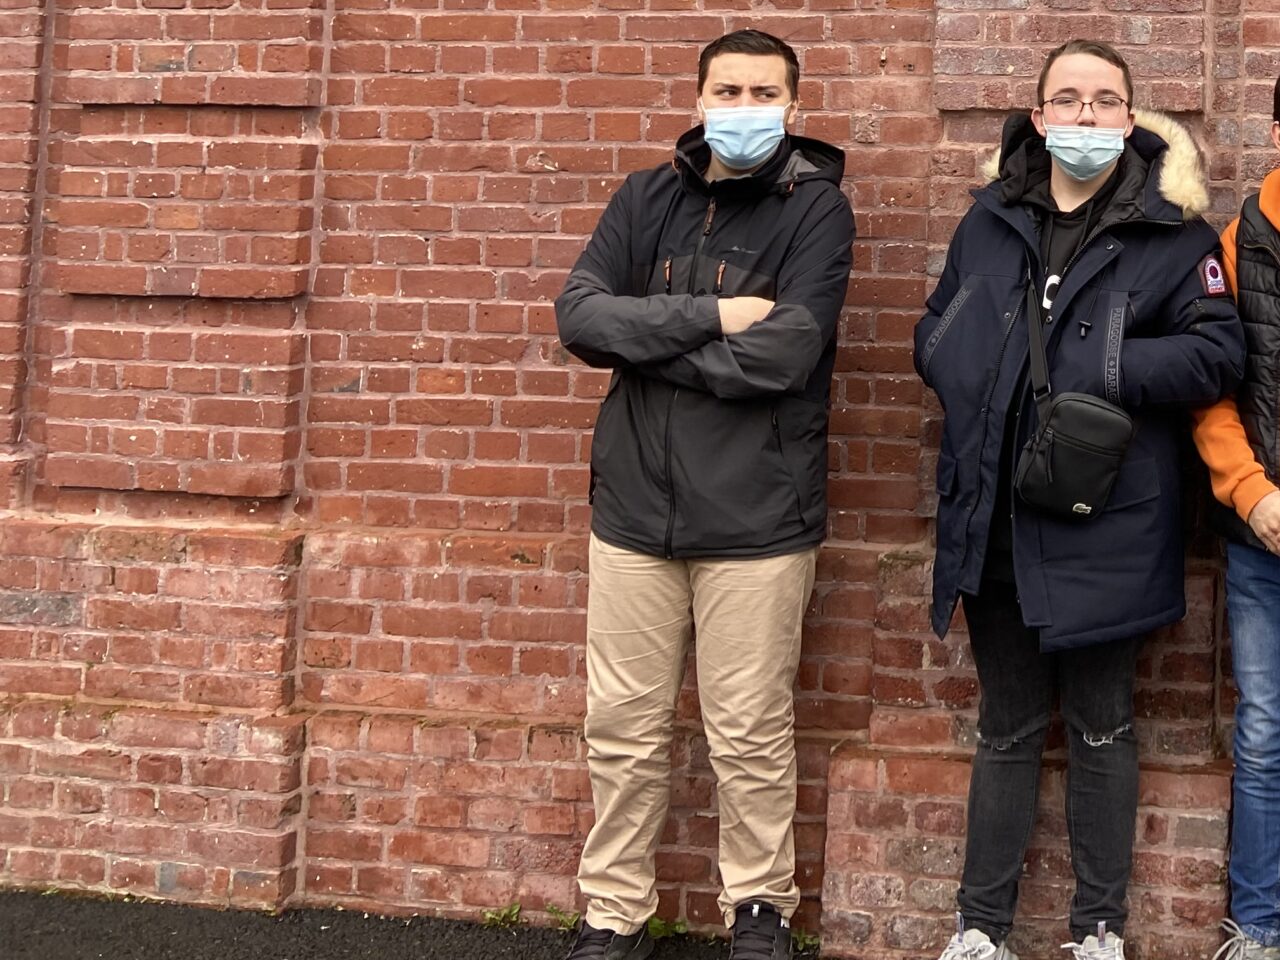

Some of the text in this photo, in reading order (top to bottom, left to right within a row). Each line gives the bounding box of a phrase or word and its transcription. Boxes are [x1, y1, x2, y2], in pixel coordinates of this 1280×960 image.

[934, 287, 969, 338] PARAGOOSE
[1107, 307, 1122, 404] PARAGOOSE PARAG
